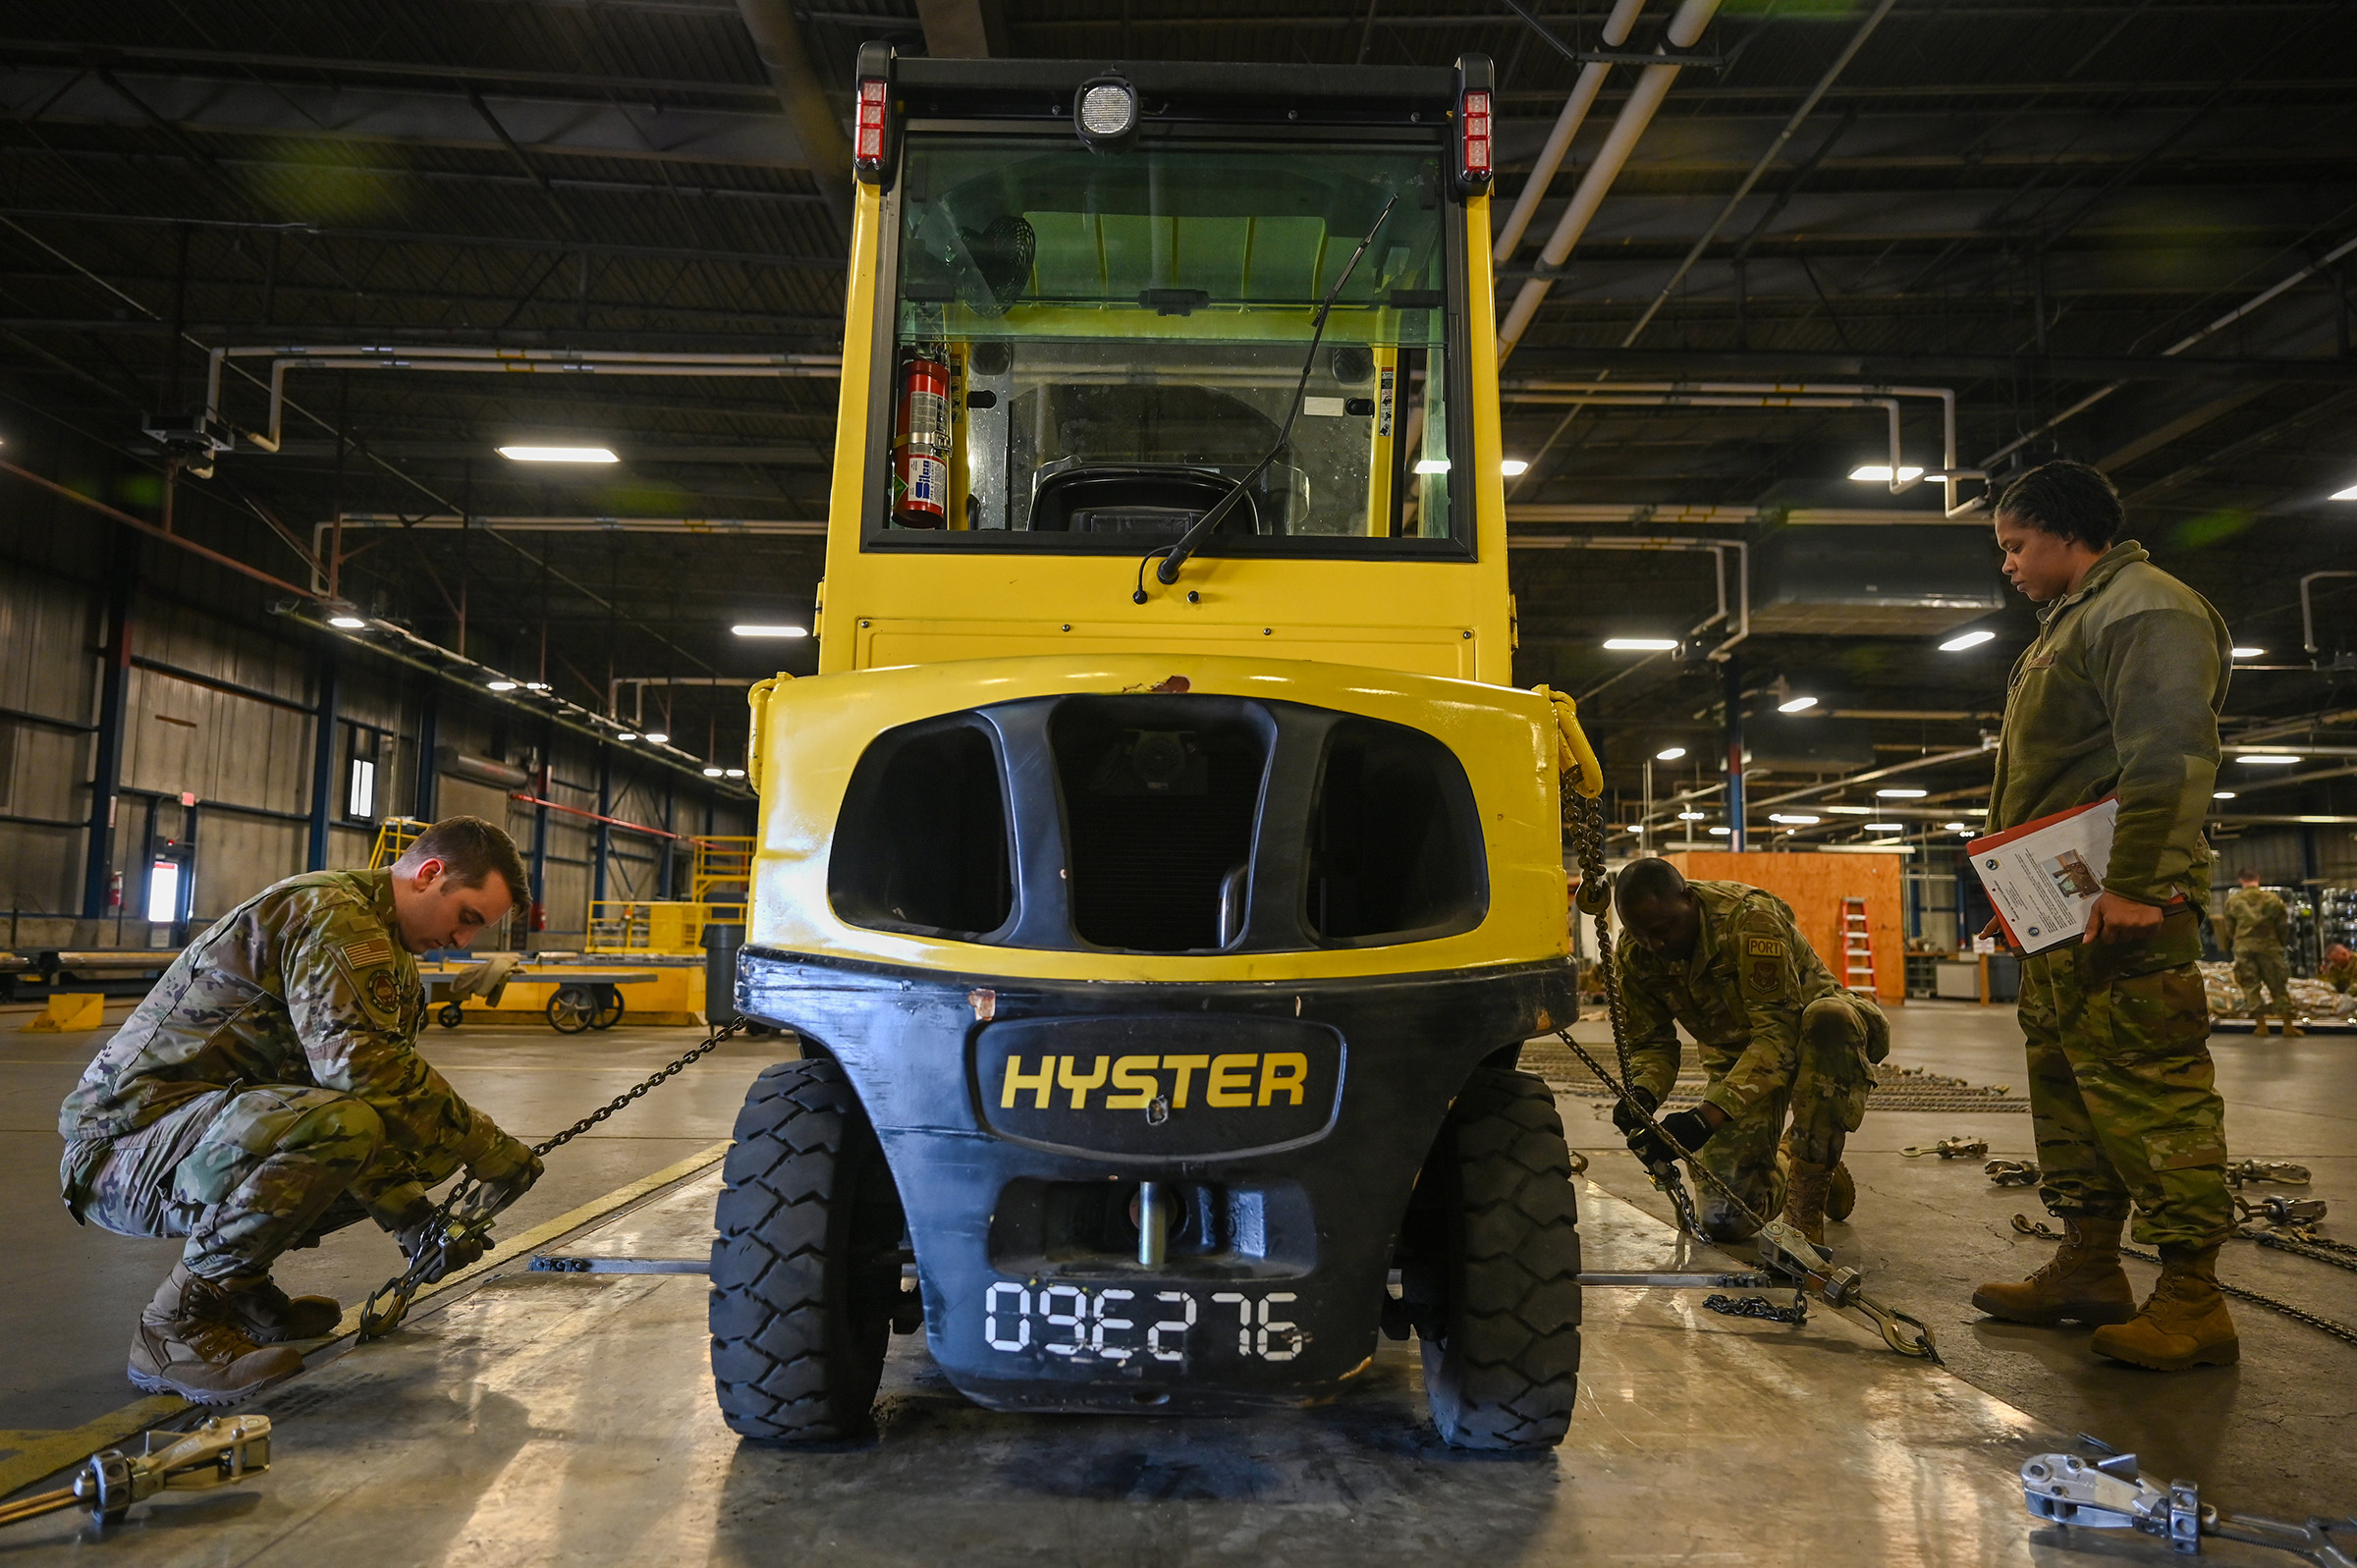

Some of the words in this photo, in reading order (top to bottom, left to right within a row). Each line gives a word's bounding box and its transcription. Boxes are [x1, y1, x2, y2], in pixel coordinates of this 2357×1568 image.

[915, 460, 930, 499] Silco
[1750, 940, 1780, 953] PORT
[1000, 1052, 1308, 1109] HYSTER
[985, 1281, 1303, 1361] 09E276
